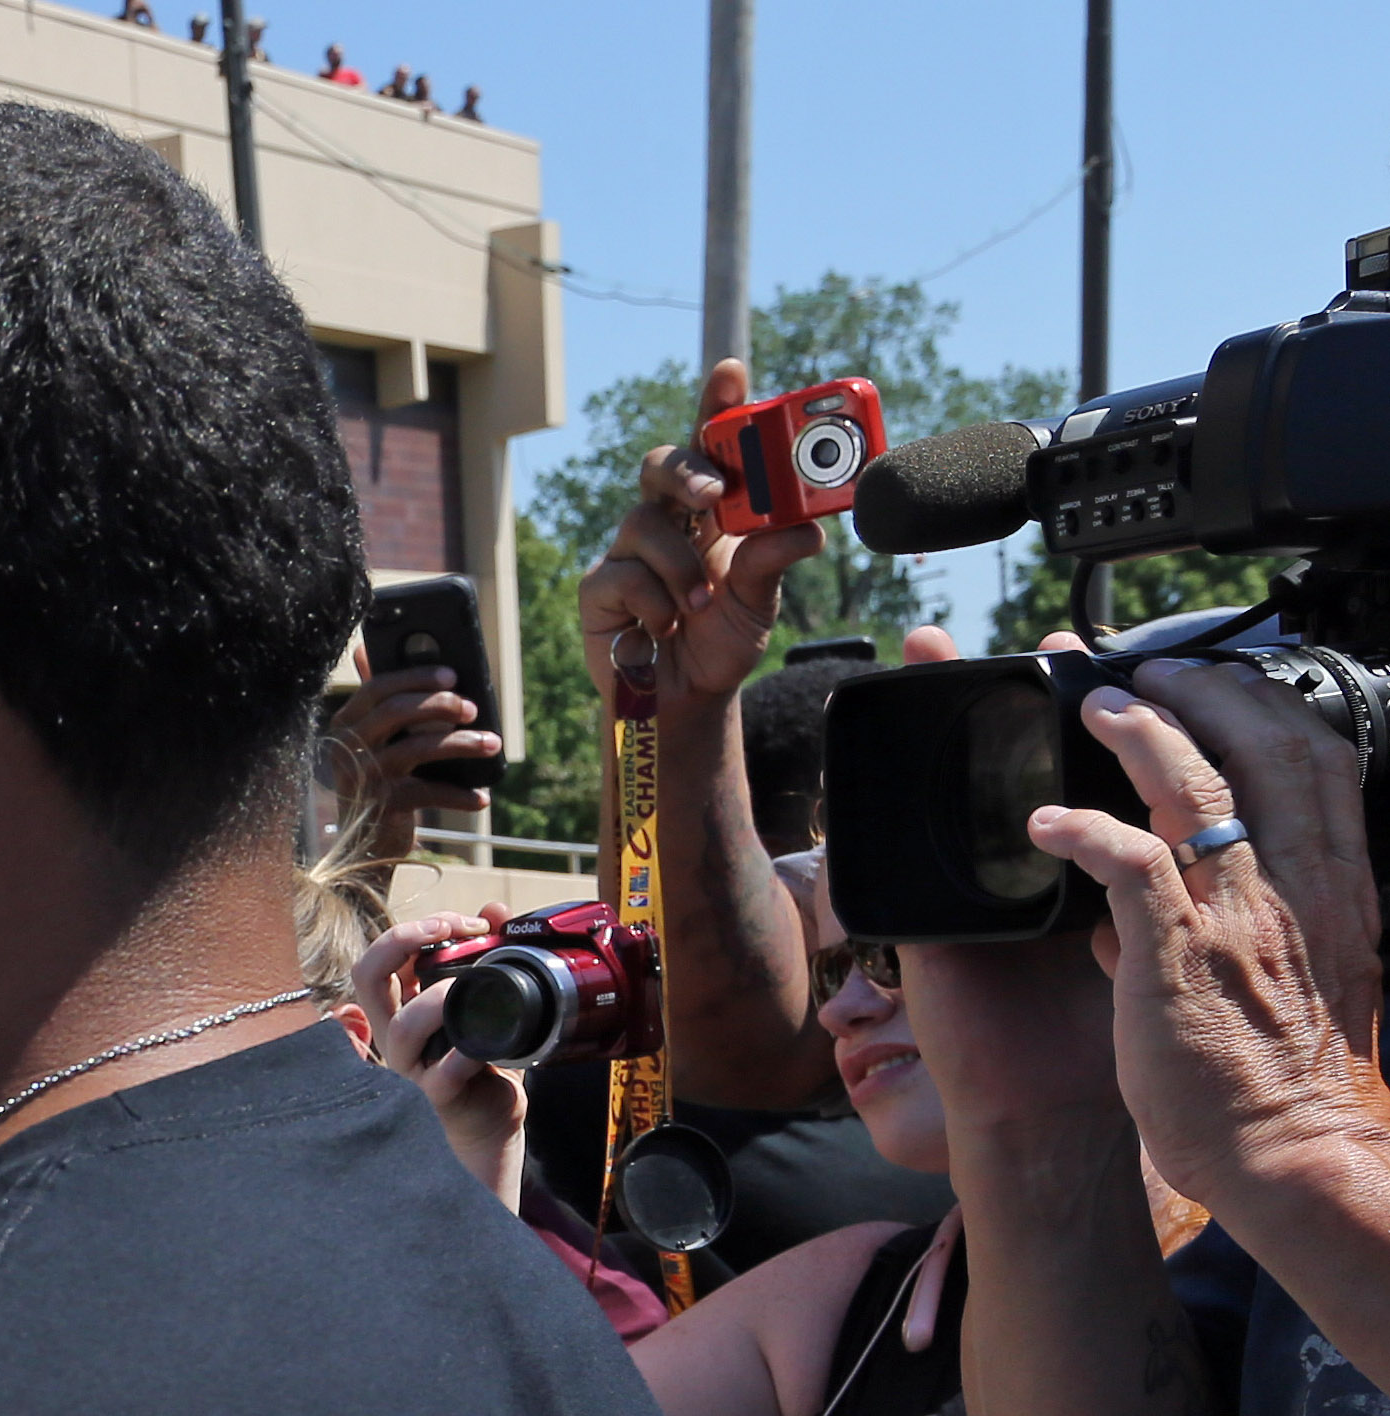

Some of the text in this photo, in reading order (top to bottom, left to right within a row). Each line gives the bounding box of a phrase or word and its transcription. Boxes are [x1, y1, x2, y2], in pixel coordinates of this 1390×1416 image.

[1123, 397, 1187, 424] SONY
[1094, 493, 1119, 504] DISPLAY
[625, 754, 636, 817] EASTERN
[506, 922, 542, 935] Kodak
